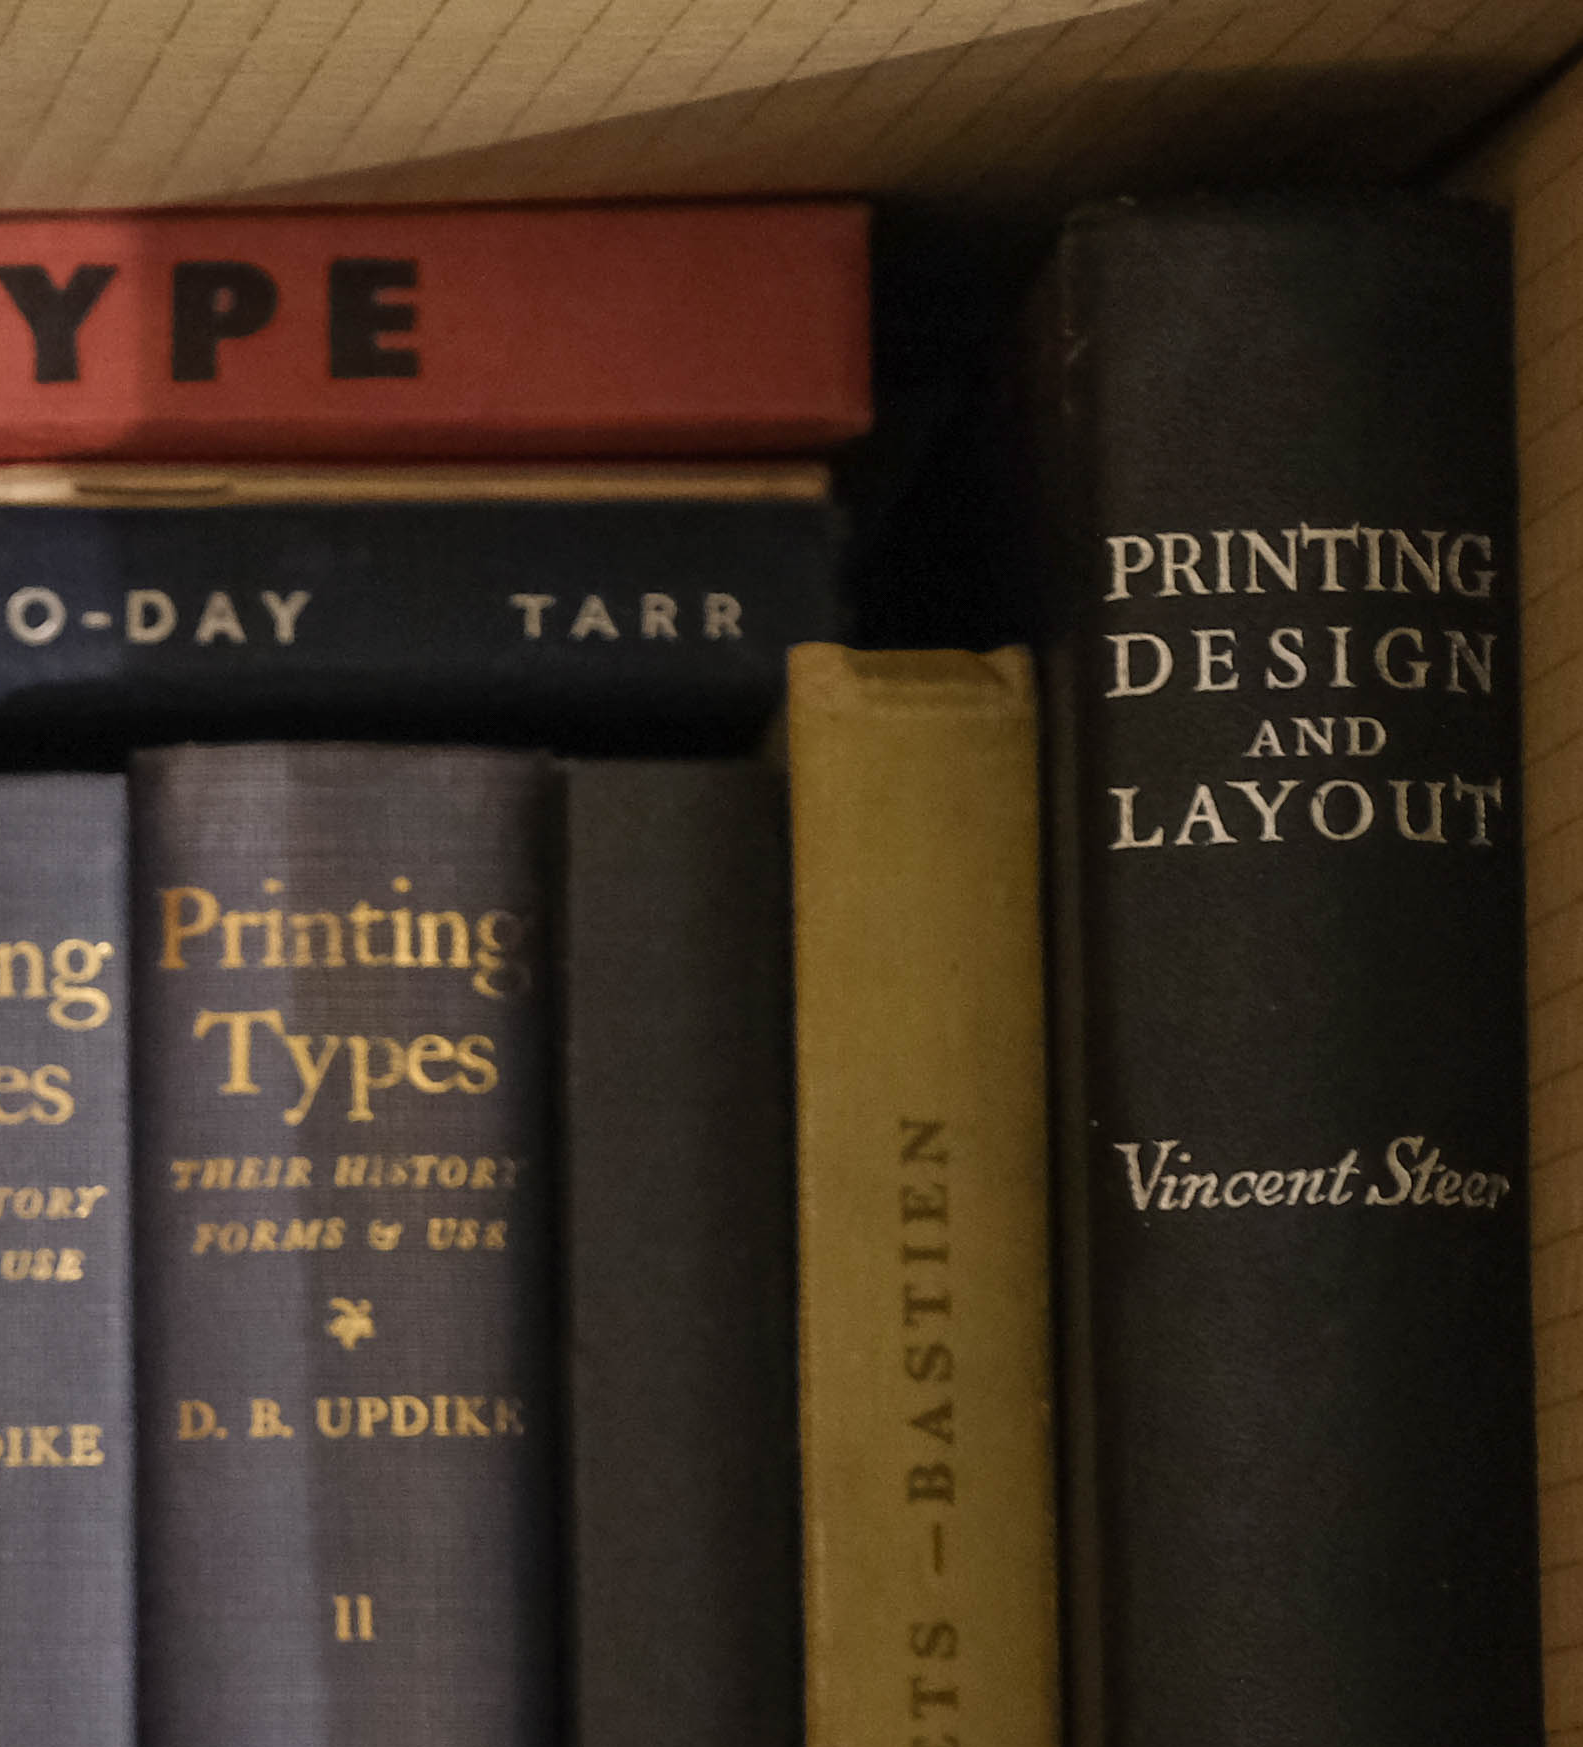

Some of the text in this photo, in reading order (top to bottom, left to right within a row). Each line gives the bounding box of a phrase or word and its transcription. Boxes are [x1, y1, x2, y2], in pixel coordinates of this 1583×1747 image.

[1103, 521, 1498, 602] PRINTING
[510, 592, 744, 641] TARR
[1103, 626, 1498, 700] DESIGN
[1241, 716, 1388, 758] AND
[1107, 773, 1504, 852] LAYOUT
[160, 875, 525, 999] Printing
[192, 1009, 499, 1126] Types
[171, 1156, 314, 1192] THEIR
[1113, 1134, 1511, 1211] Vincent Steer
[0, 1247, 87, 1283] USE
[192, 1217, 347, 1255] FORMS
[899, 1116, 957, 1506] BASTIEN
[176, 1399, 229, 1441] D.
[248, 1397, 295, 1439] B.
